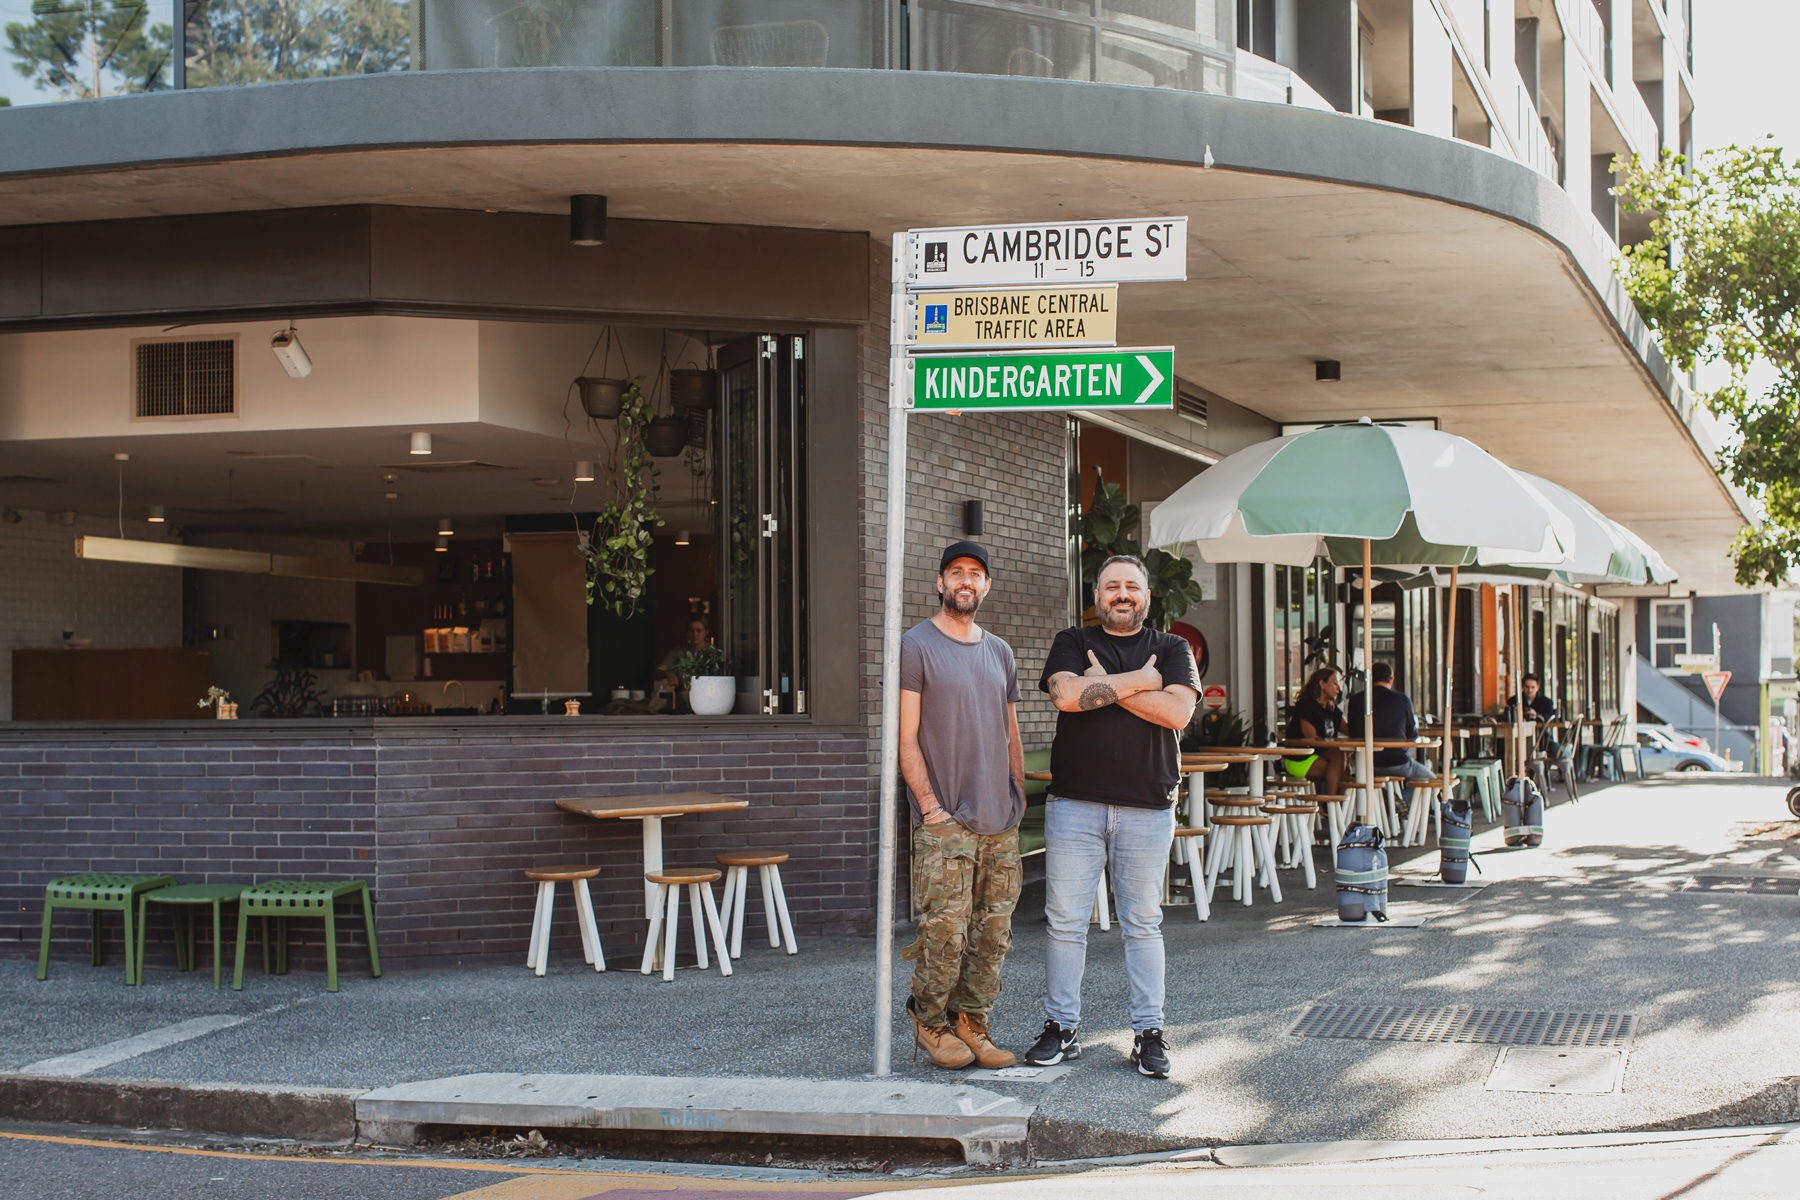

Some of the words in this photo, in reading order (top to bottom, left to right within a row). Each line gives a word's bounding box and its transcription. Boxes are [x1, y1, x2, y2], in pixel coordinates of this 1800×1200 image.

[963, 226, 1132, 263] CAMBRIDGE
[1145, 224, 1173, 257] ST
[1034, 262, 1044, 278] 11
[1079, 260, 1095, 277] 15
[954, 295, 1030, 316] BRISBANE
[1037, 293, 1109, 313] CENTRAL
[975, 319, 1038, 340] TRAFFIC
[1044, 318, 1086, 338] AREA
[925, 363, 1122, 399] KINDERGARTEN
